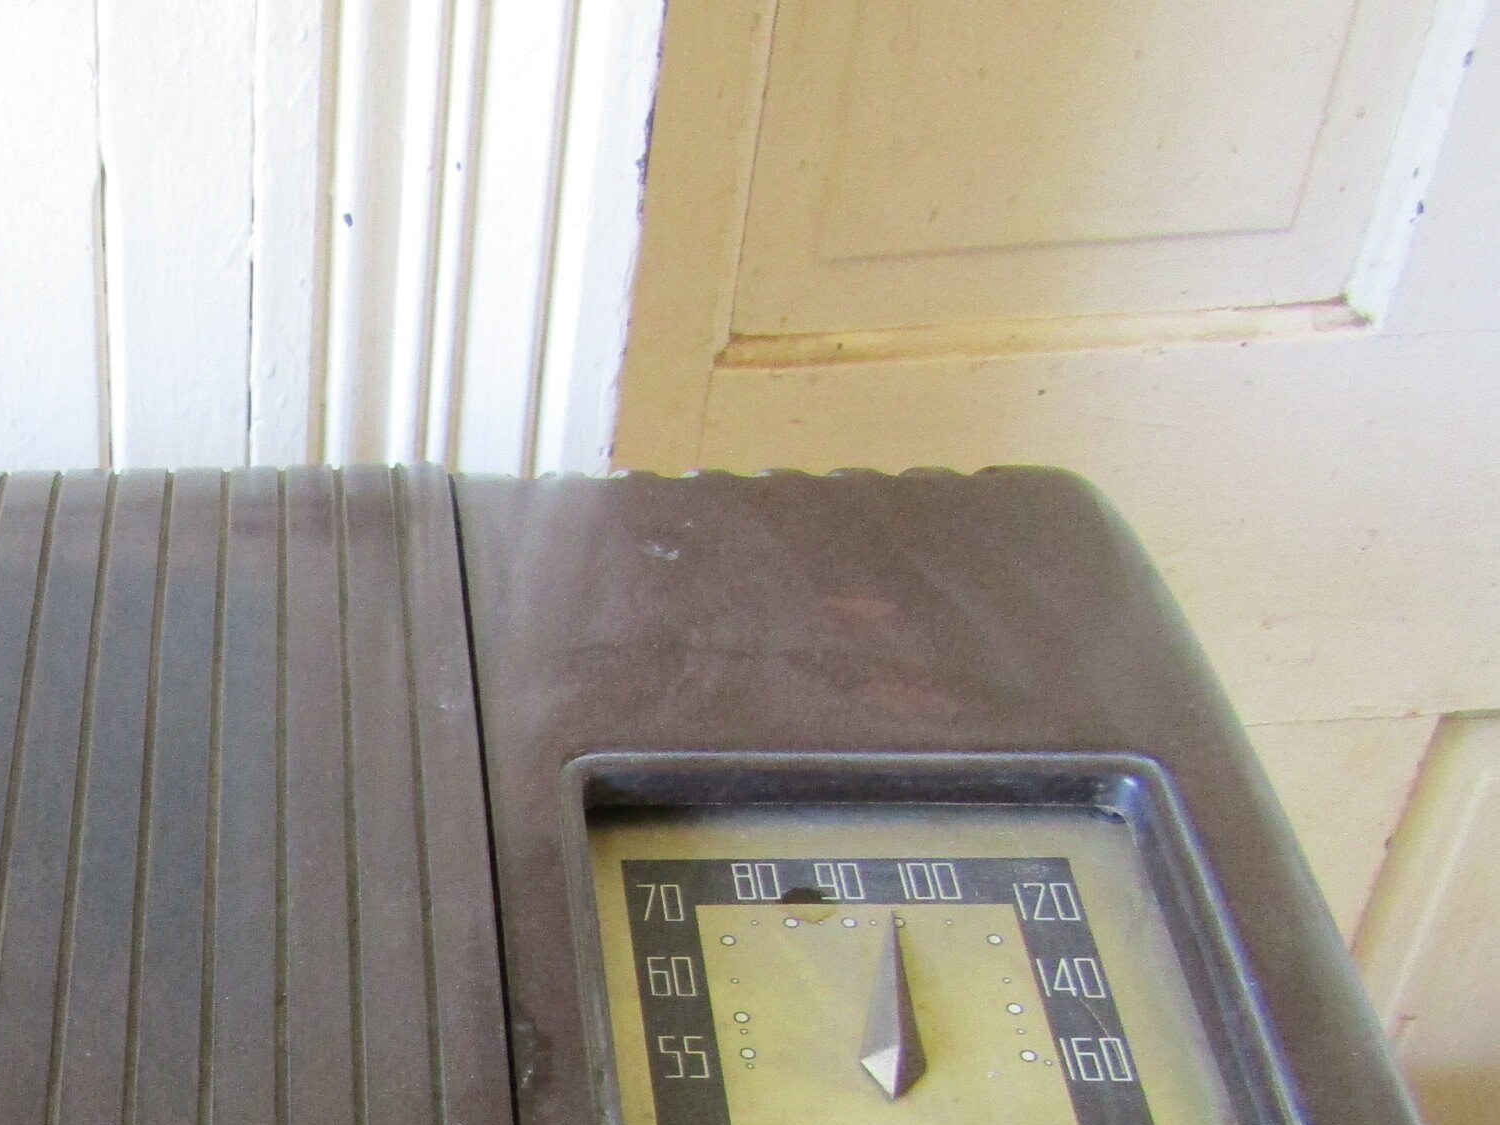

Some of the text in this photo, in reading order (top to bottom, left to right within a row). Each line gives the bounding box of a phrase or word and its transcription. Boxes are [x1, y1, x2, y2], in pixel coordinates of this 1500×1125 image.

[730, 862, 963, 901] 80 90 100
[1013, 882, 1082, 922] 120
[636, 883, 685, 922] 70
[647, 956, 697, 997] 60
[1035, 957, 1106, 999] 140
[657, 1035, 711, 1079] 55
[1060, 1036, 1133, 1082] 160
